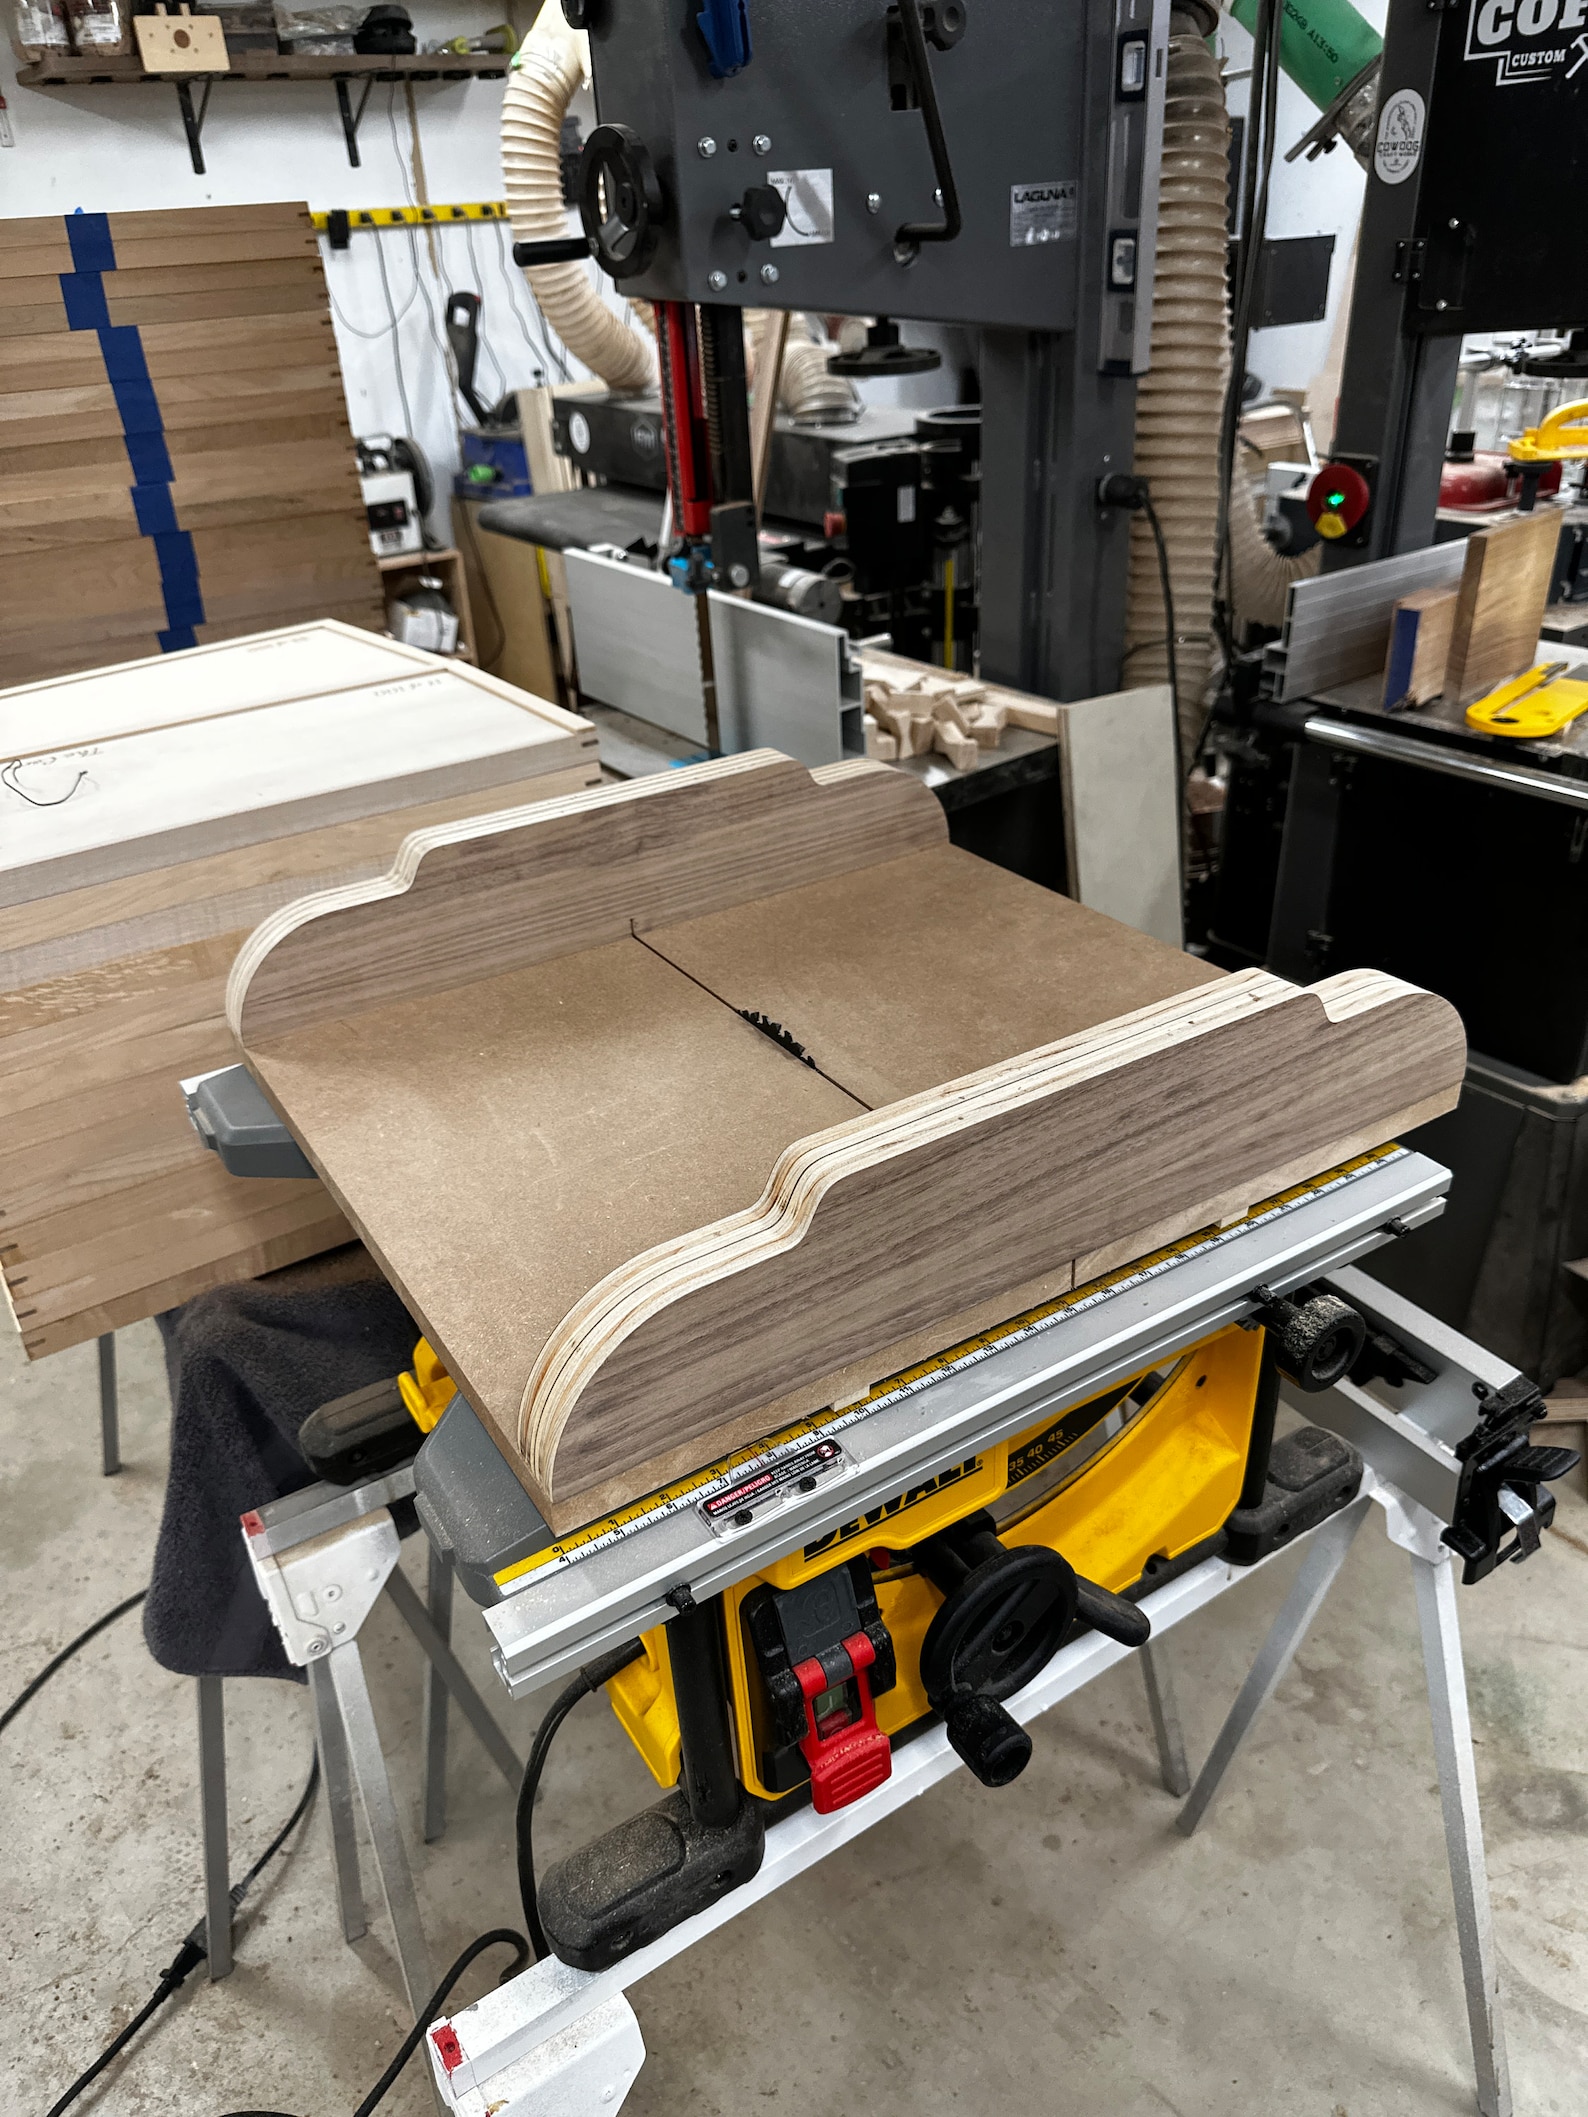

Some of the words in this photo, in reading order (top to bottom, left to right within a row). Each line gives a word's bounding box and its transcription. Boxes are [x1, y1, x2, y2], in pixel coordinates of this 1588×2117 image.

[1511, 48, 1567, 67] CUSTOM
[1014, 188, 1067, 203] LAGUNA
[1009, 1456, 1024, 1471] 35
[1027, 1444, 1043, 1457] 40
[1047, 1428, 1064, 1442] 45
[715, 1474, 771, 1506] DANGER/PELIGRO
